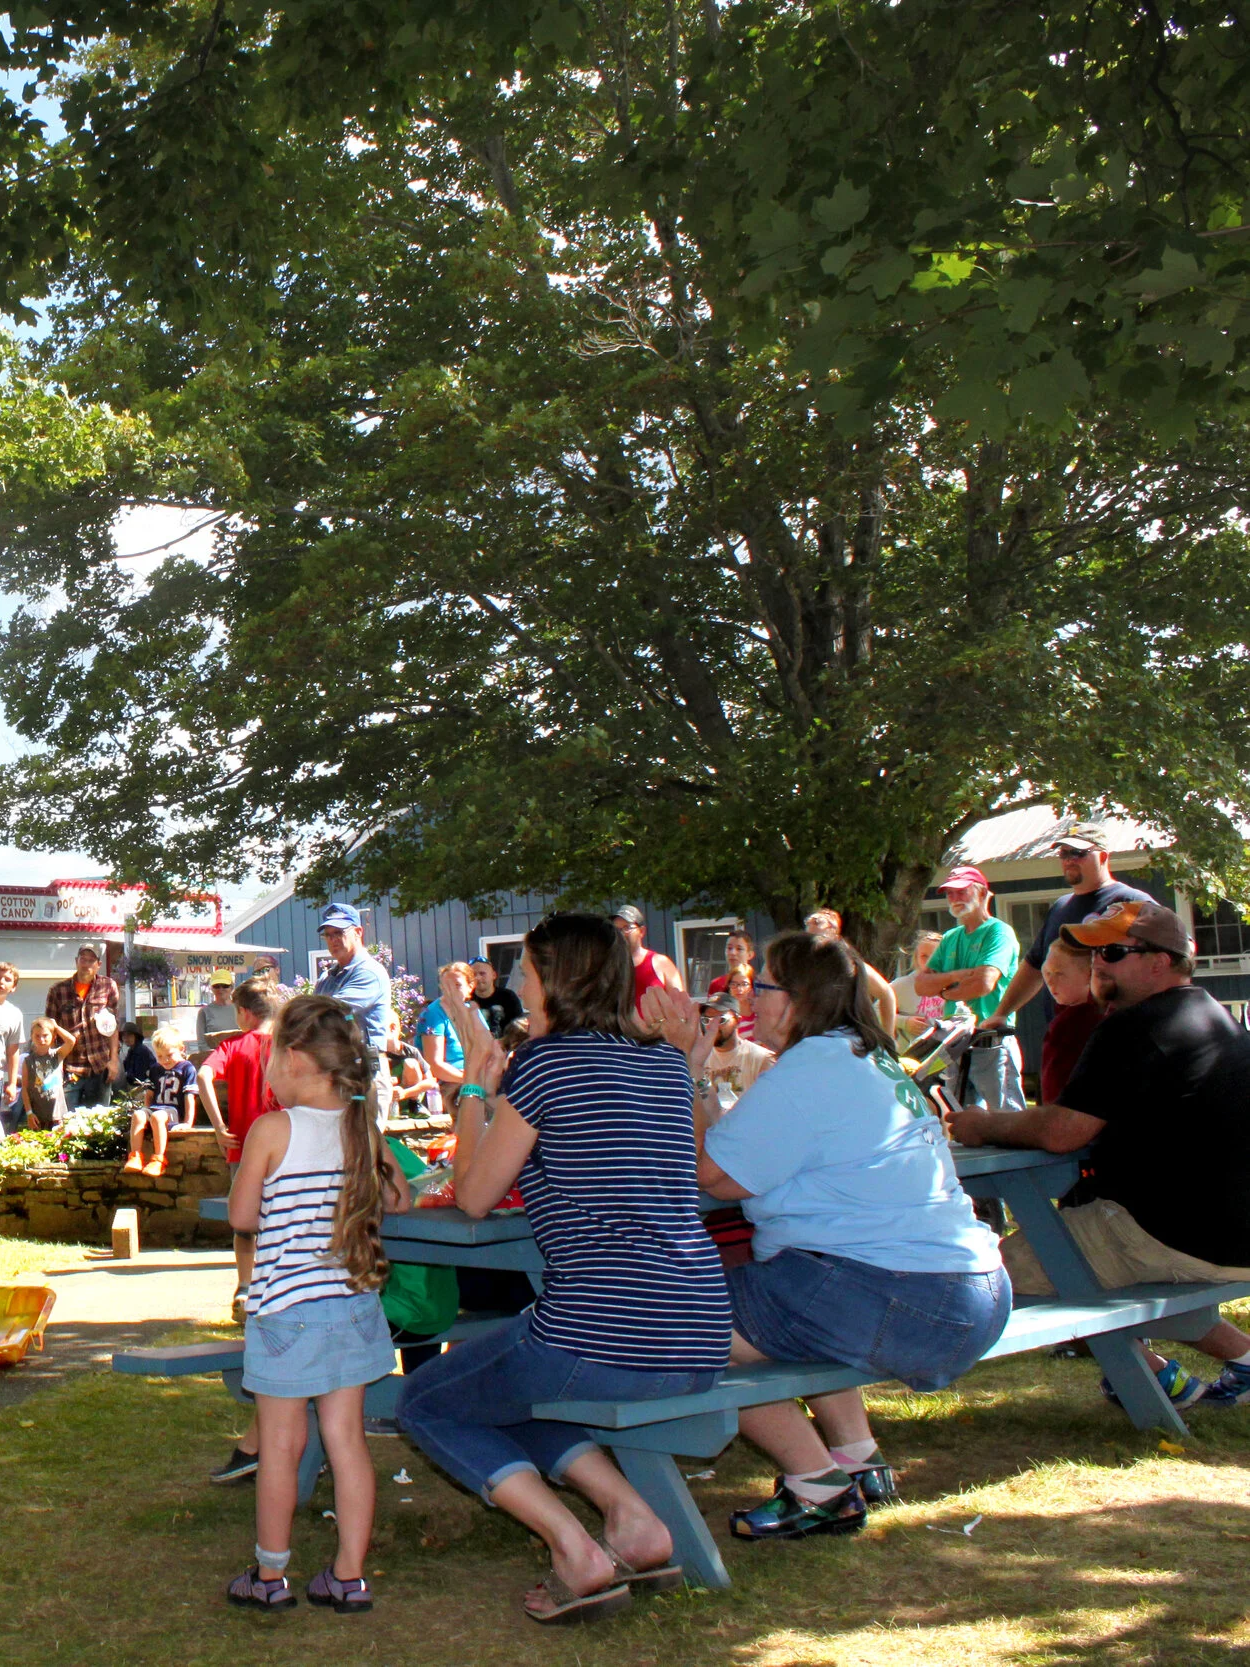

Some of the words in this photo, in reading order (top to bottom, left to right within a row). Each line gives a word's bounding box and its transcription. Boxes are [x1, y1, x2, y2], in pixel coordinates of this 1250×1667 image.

[0, 896, 36, 907] COTTON
[56, 896, 75, 913] POP
[1, 907, 34, 918] CANDY
[73, 905, 99, 918] CORN
[186, 955, 212, 966] SNOW
[216, 954, 245, 965] CONES
[156, 1075, 179, 1106] 12
